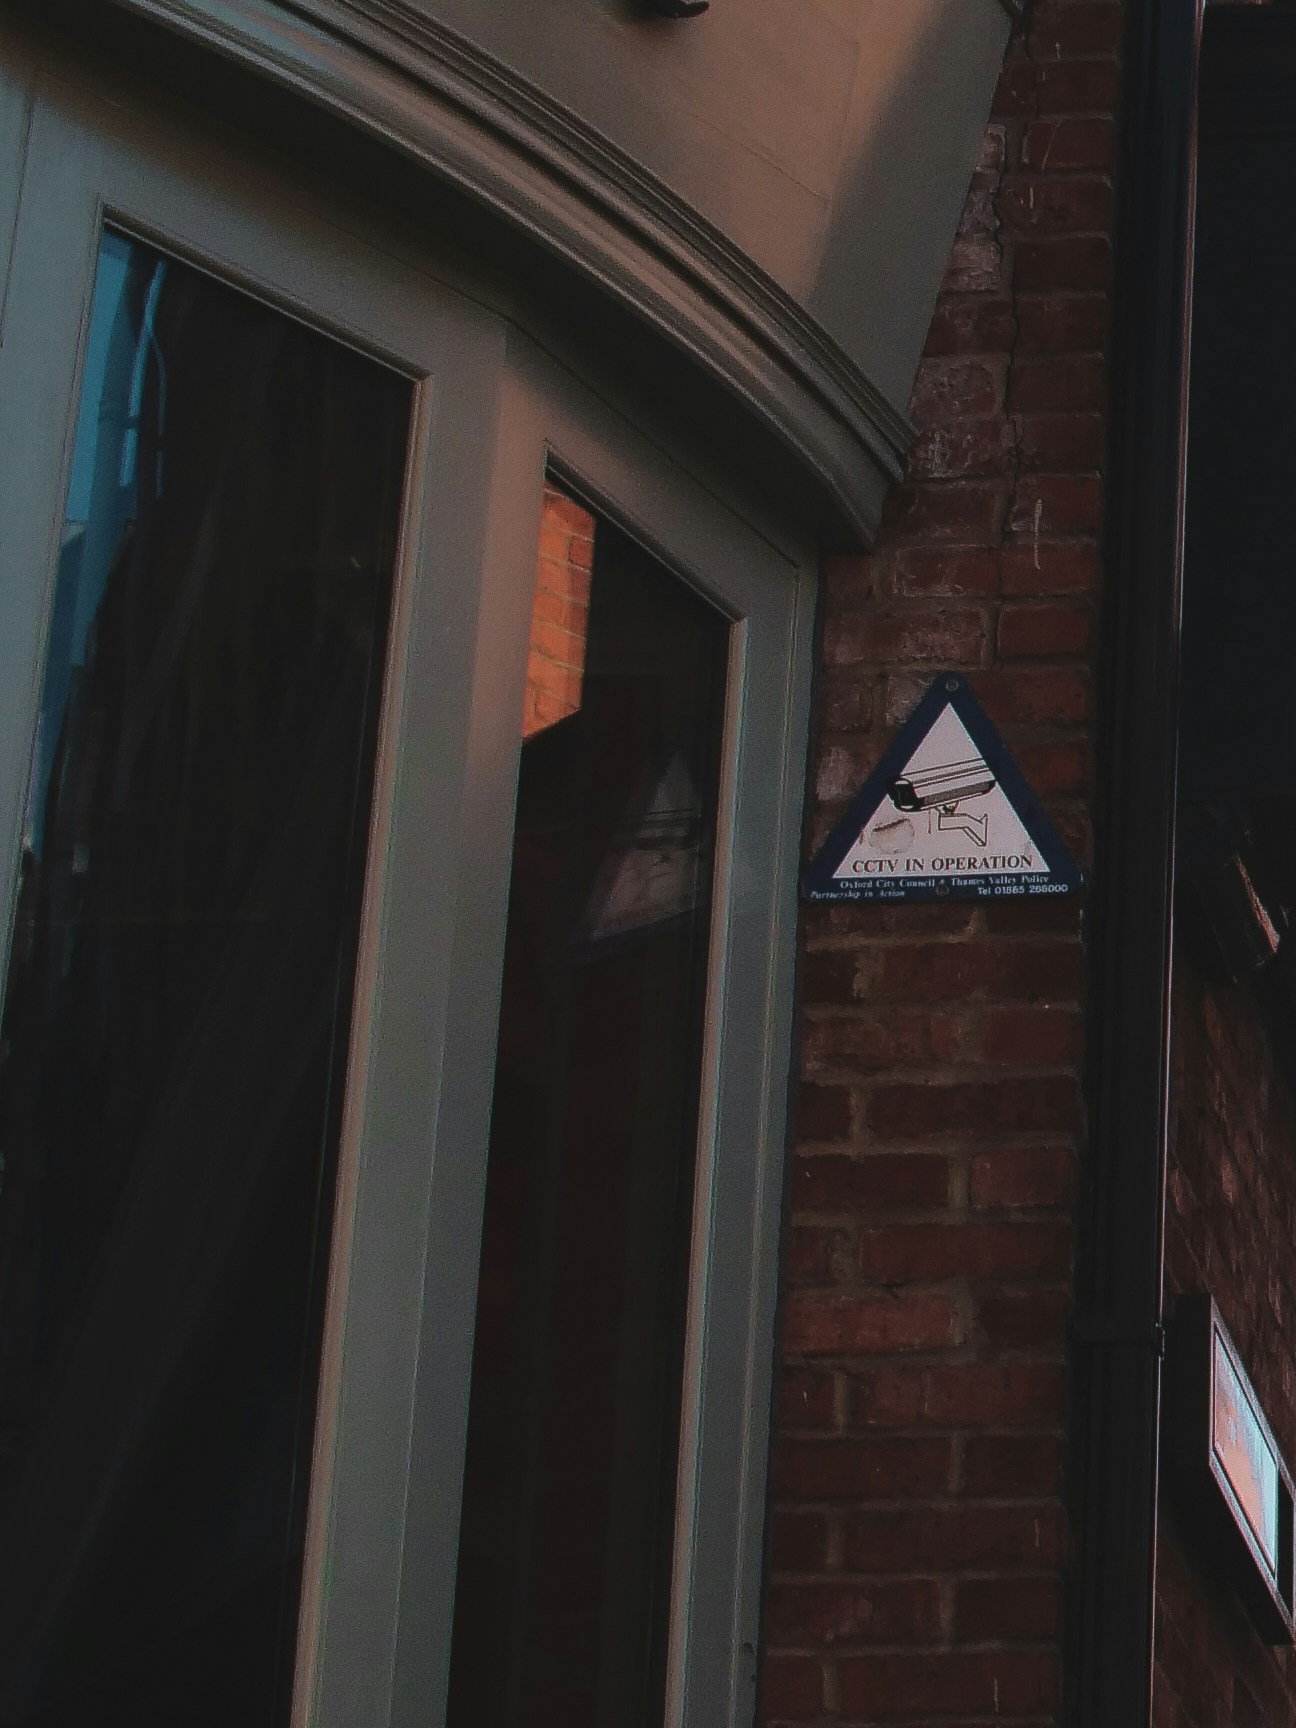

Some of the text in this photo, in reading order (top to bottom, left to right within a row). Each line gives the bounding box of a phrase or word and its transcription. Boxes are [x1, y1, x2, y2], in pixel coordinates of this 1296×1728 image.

[852, 854, 1033, 873] CCTV IN OPERATION
[840, 880, 873, 889] Oxford
[876, 879, 895, 889] City
[899, 878, 936, 888] Council
[952, 877, 985, 886] Thames
[989, 876, 1017, 886] Valley
[1021, 875, 1050, 884] Police
[977, 886, 991, 895] Tel
